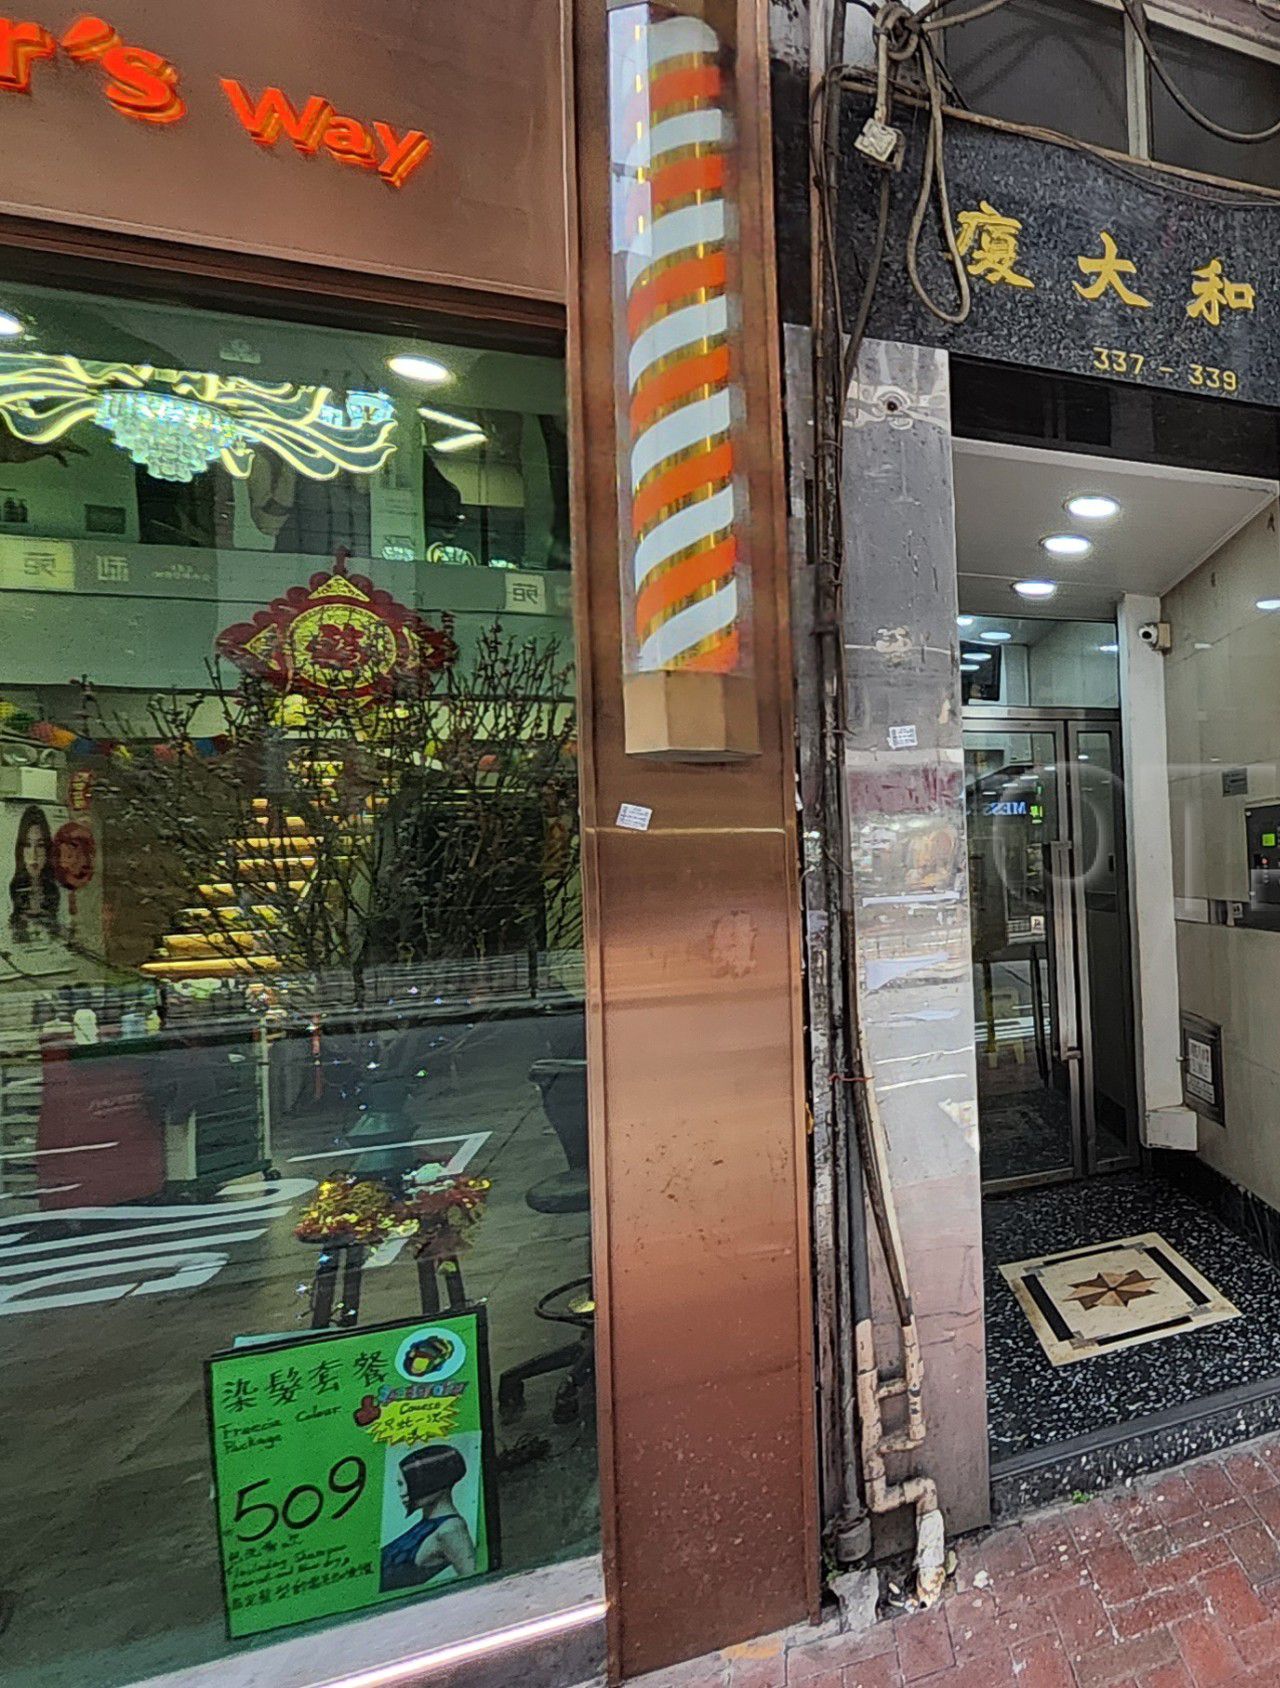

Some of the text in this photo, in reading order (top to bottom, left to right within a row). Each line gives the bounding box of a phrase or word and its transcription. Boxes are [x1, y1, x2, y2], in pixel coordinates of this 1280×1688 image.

[220, 77, 432, 187] Way
[1093, 347, 1145, 376] 337
[1189, 364, 1238, 392] 339
[221, 1350, 389, 1414] 染髮套餐
[232, 1455, 367, 1542] 509
